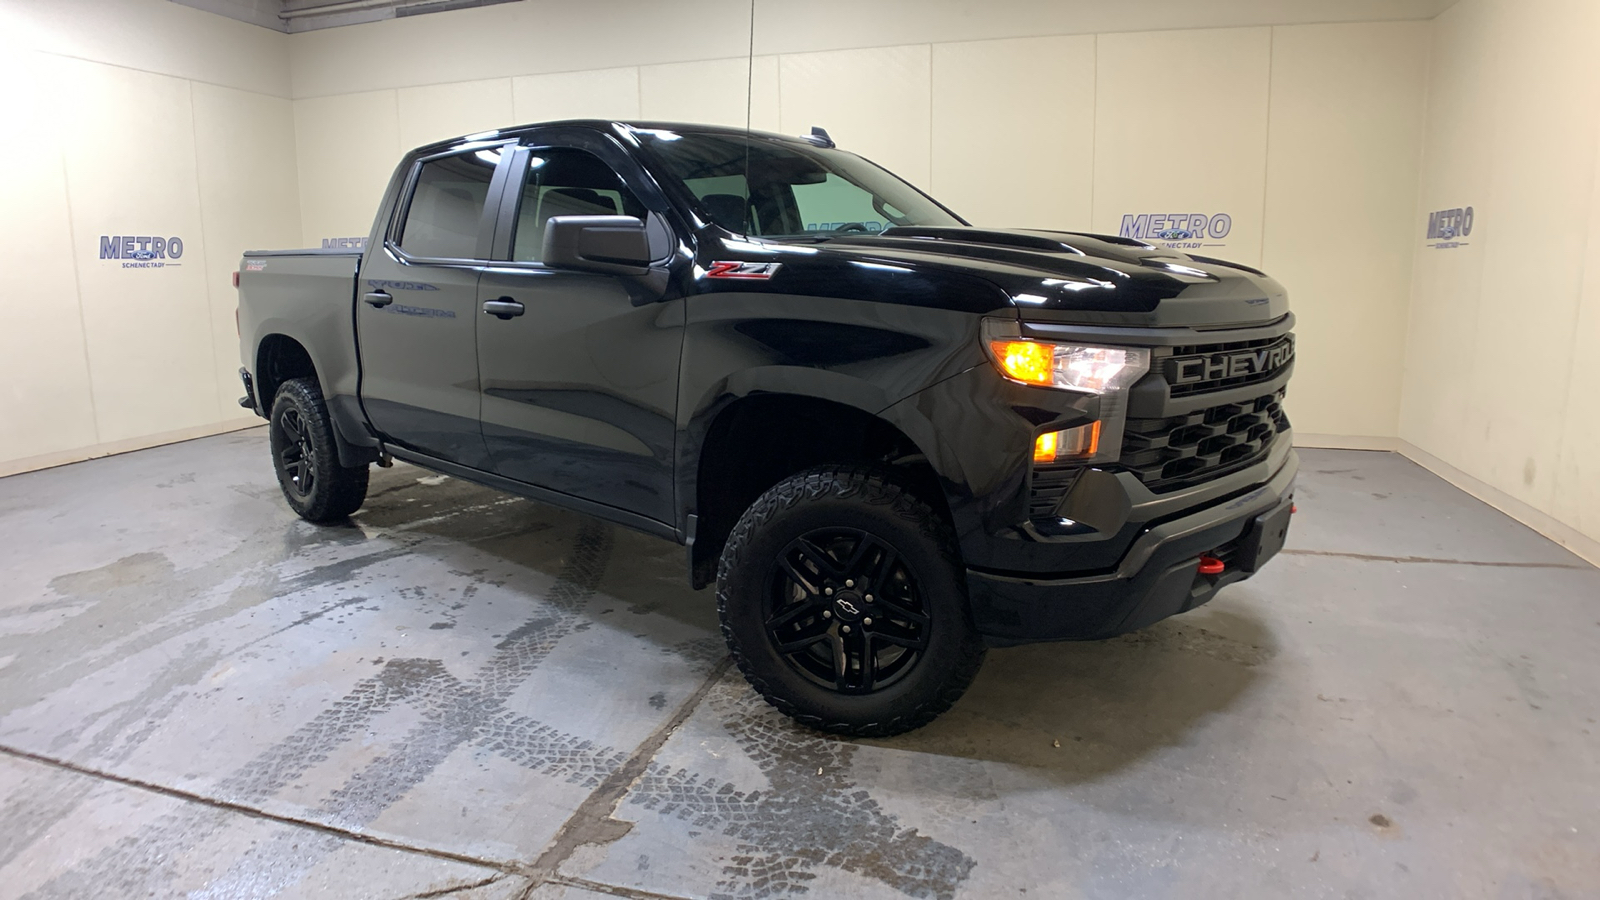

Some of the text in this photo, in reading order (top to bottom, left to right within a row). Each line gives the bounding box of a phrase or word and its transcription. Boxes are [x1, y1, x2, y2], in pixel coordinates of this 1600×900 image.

[1119, 213, 1232, 239] METRO
[1427, 206, 1474, 239] METRO
[99, 236, 184, 259] METRO
[1176, 340, 1295, 384] CHEVROL
